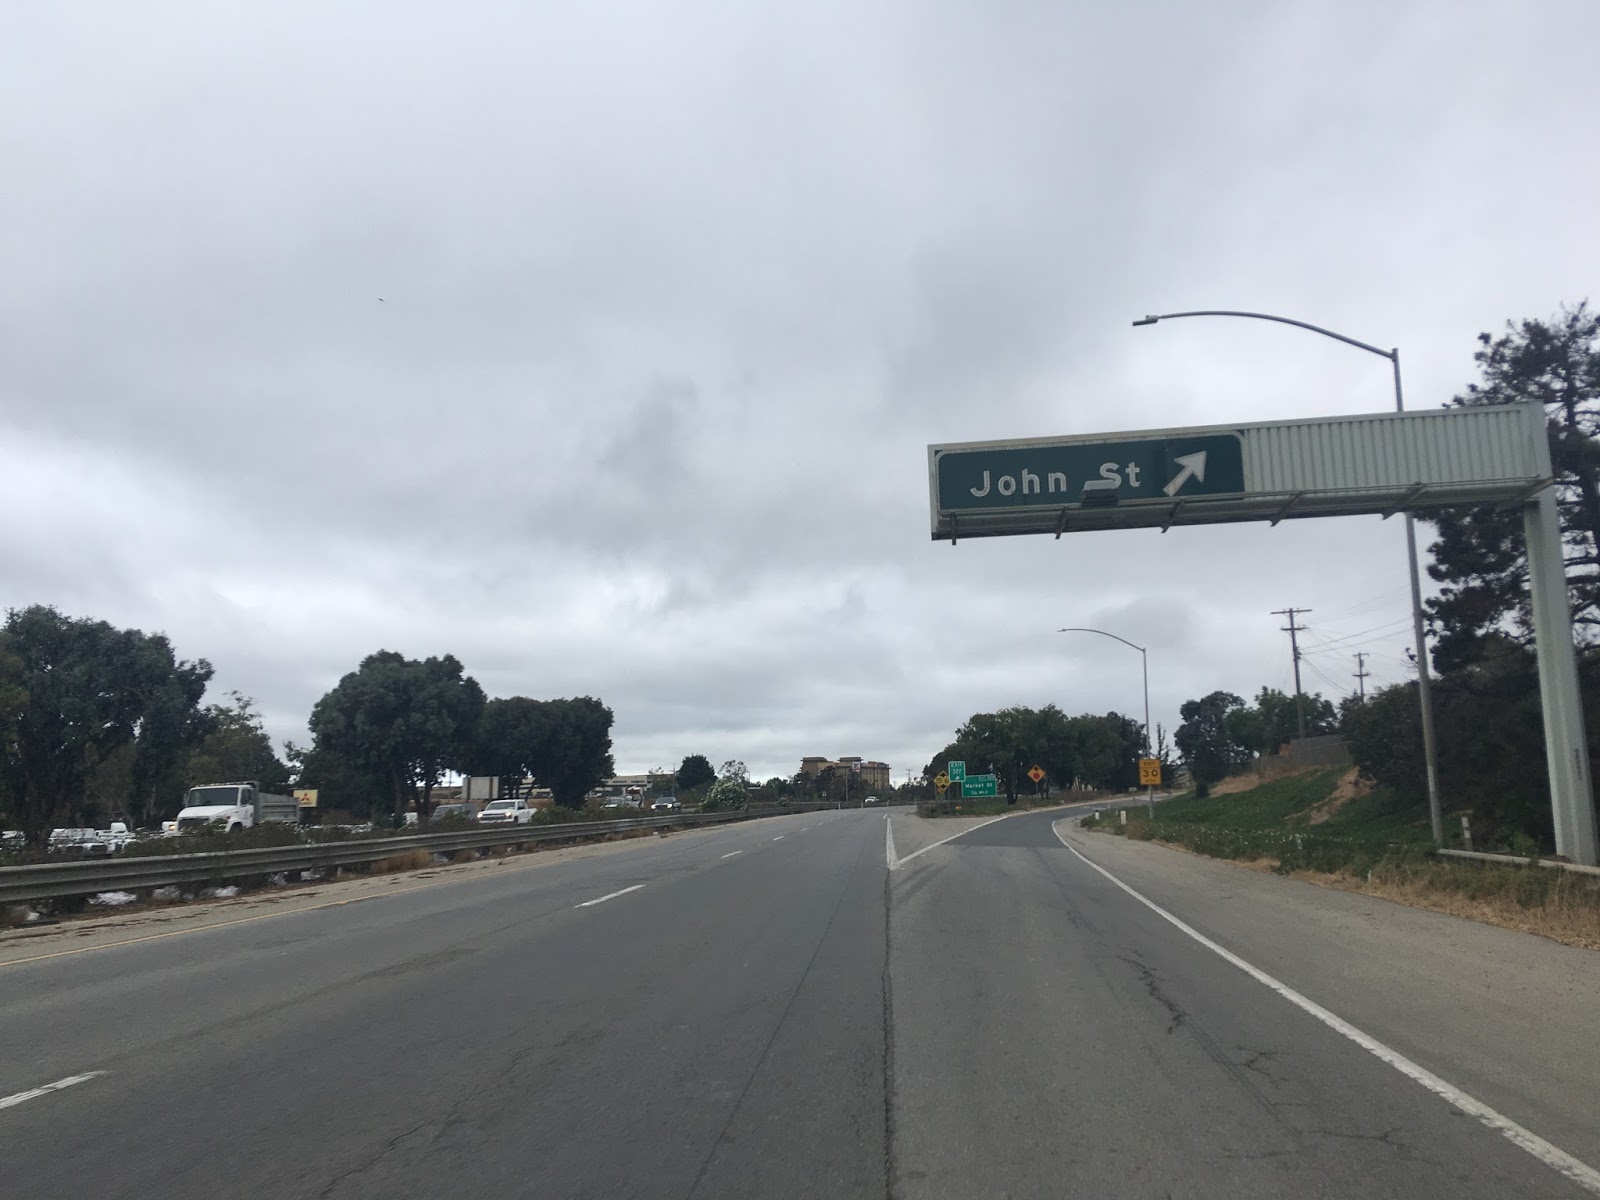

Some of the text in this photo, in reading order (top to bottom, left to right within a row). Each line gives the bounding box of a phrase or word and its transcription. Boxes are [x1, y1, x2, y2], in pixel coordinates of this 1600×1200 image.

[970, 461, 1141, 498] John St
[1143, 769, 1158, 777] 30
